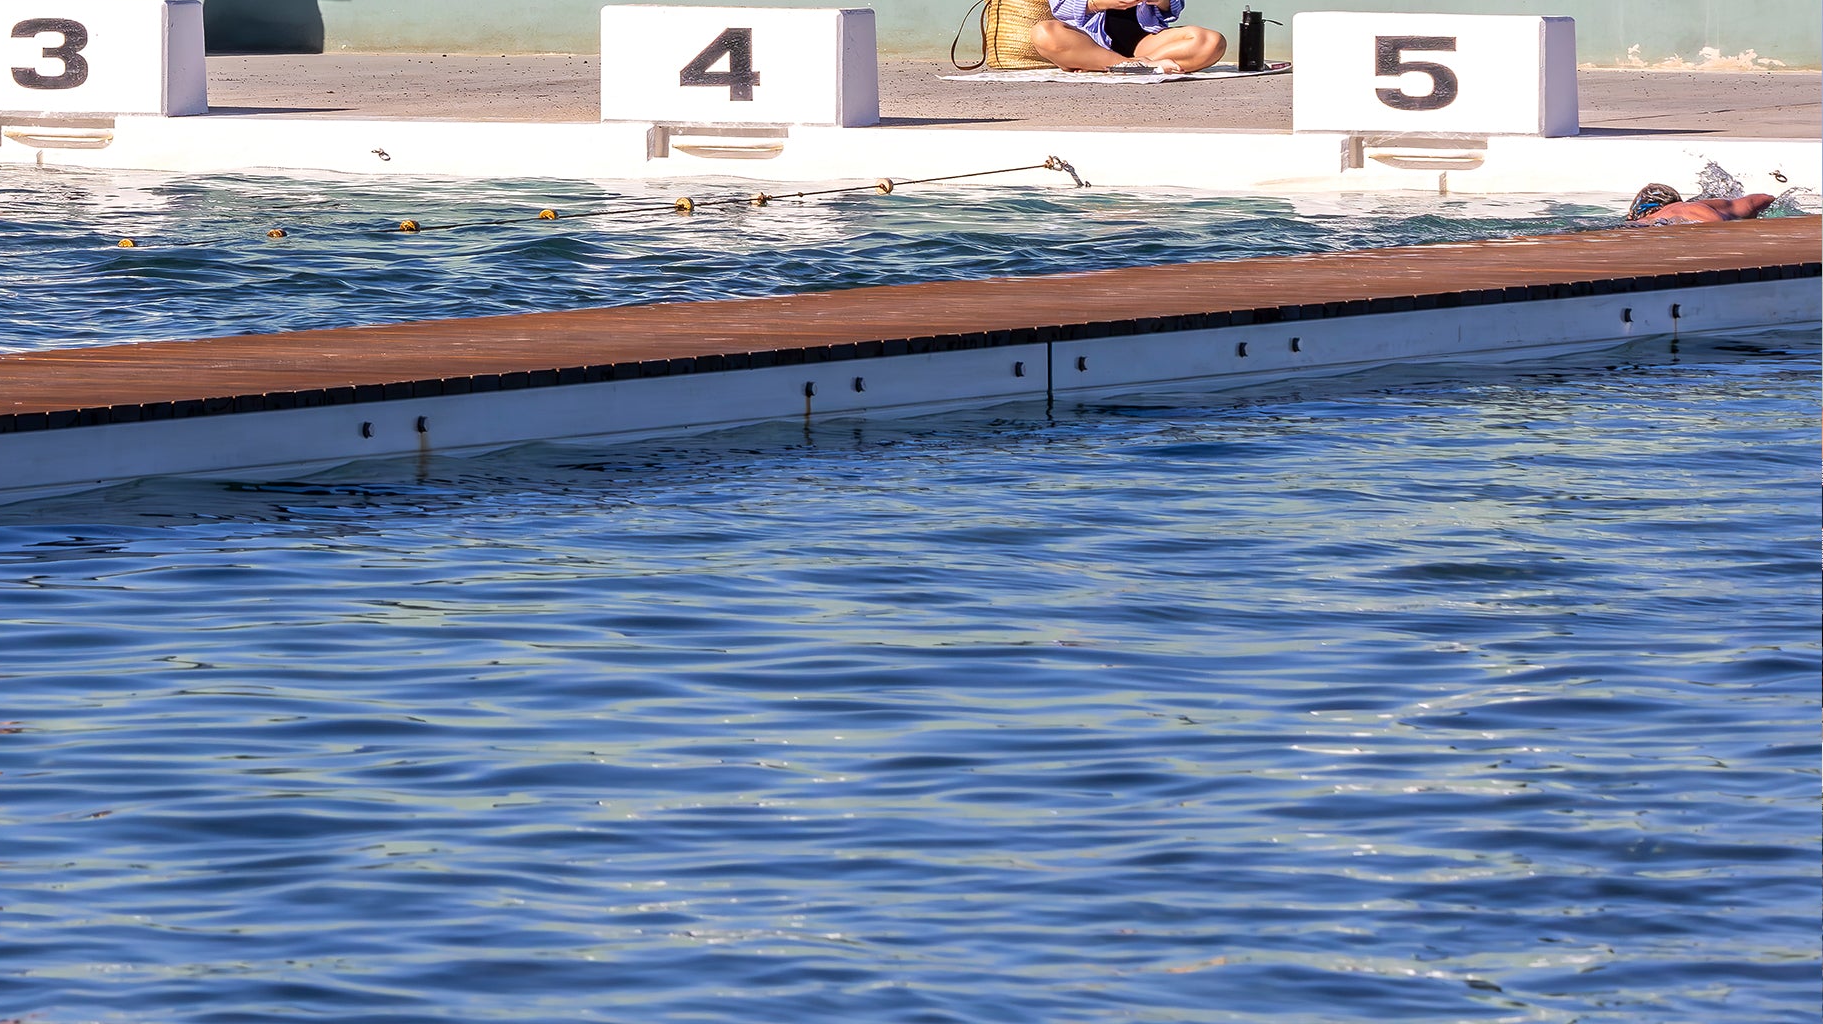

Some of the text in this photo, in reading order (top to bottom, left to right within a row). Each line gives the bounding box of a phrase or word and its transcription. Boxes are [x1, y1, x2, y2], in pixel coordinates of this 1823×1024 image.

[11, 17, 88, 90] 3
[680, 27, 760, 101] 4
[1375, 35, 1457, 111] 5
